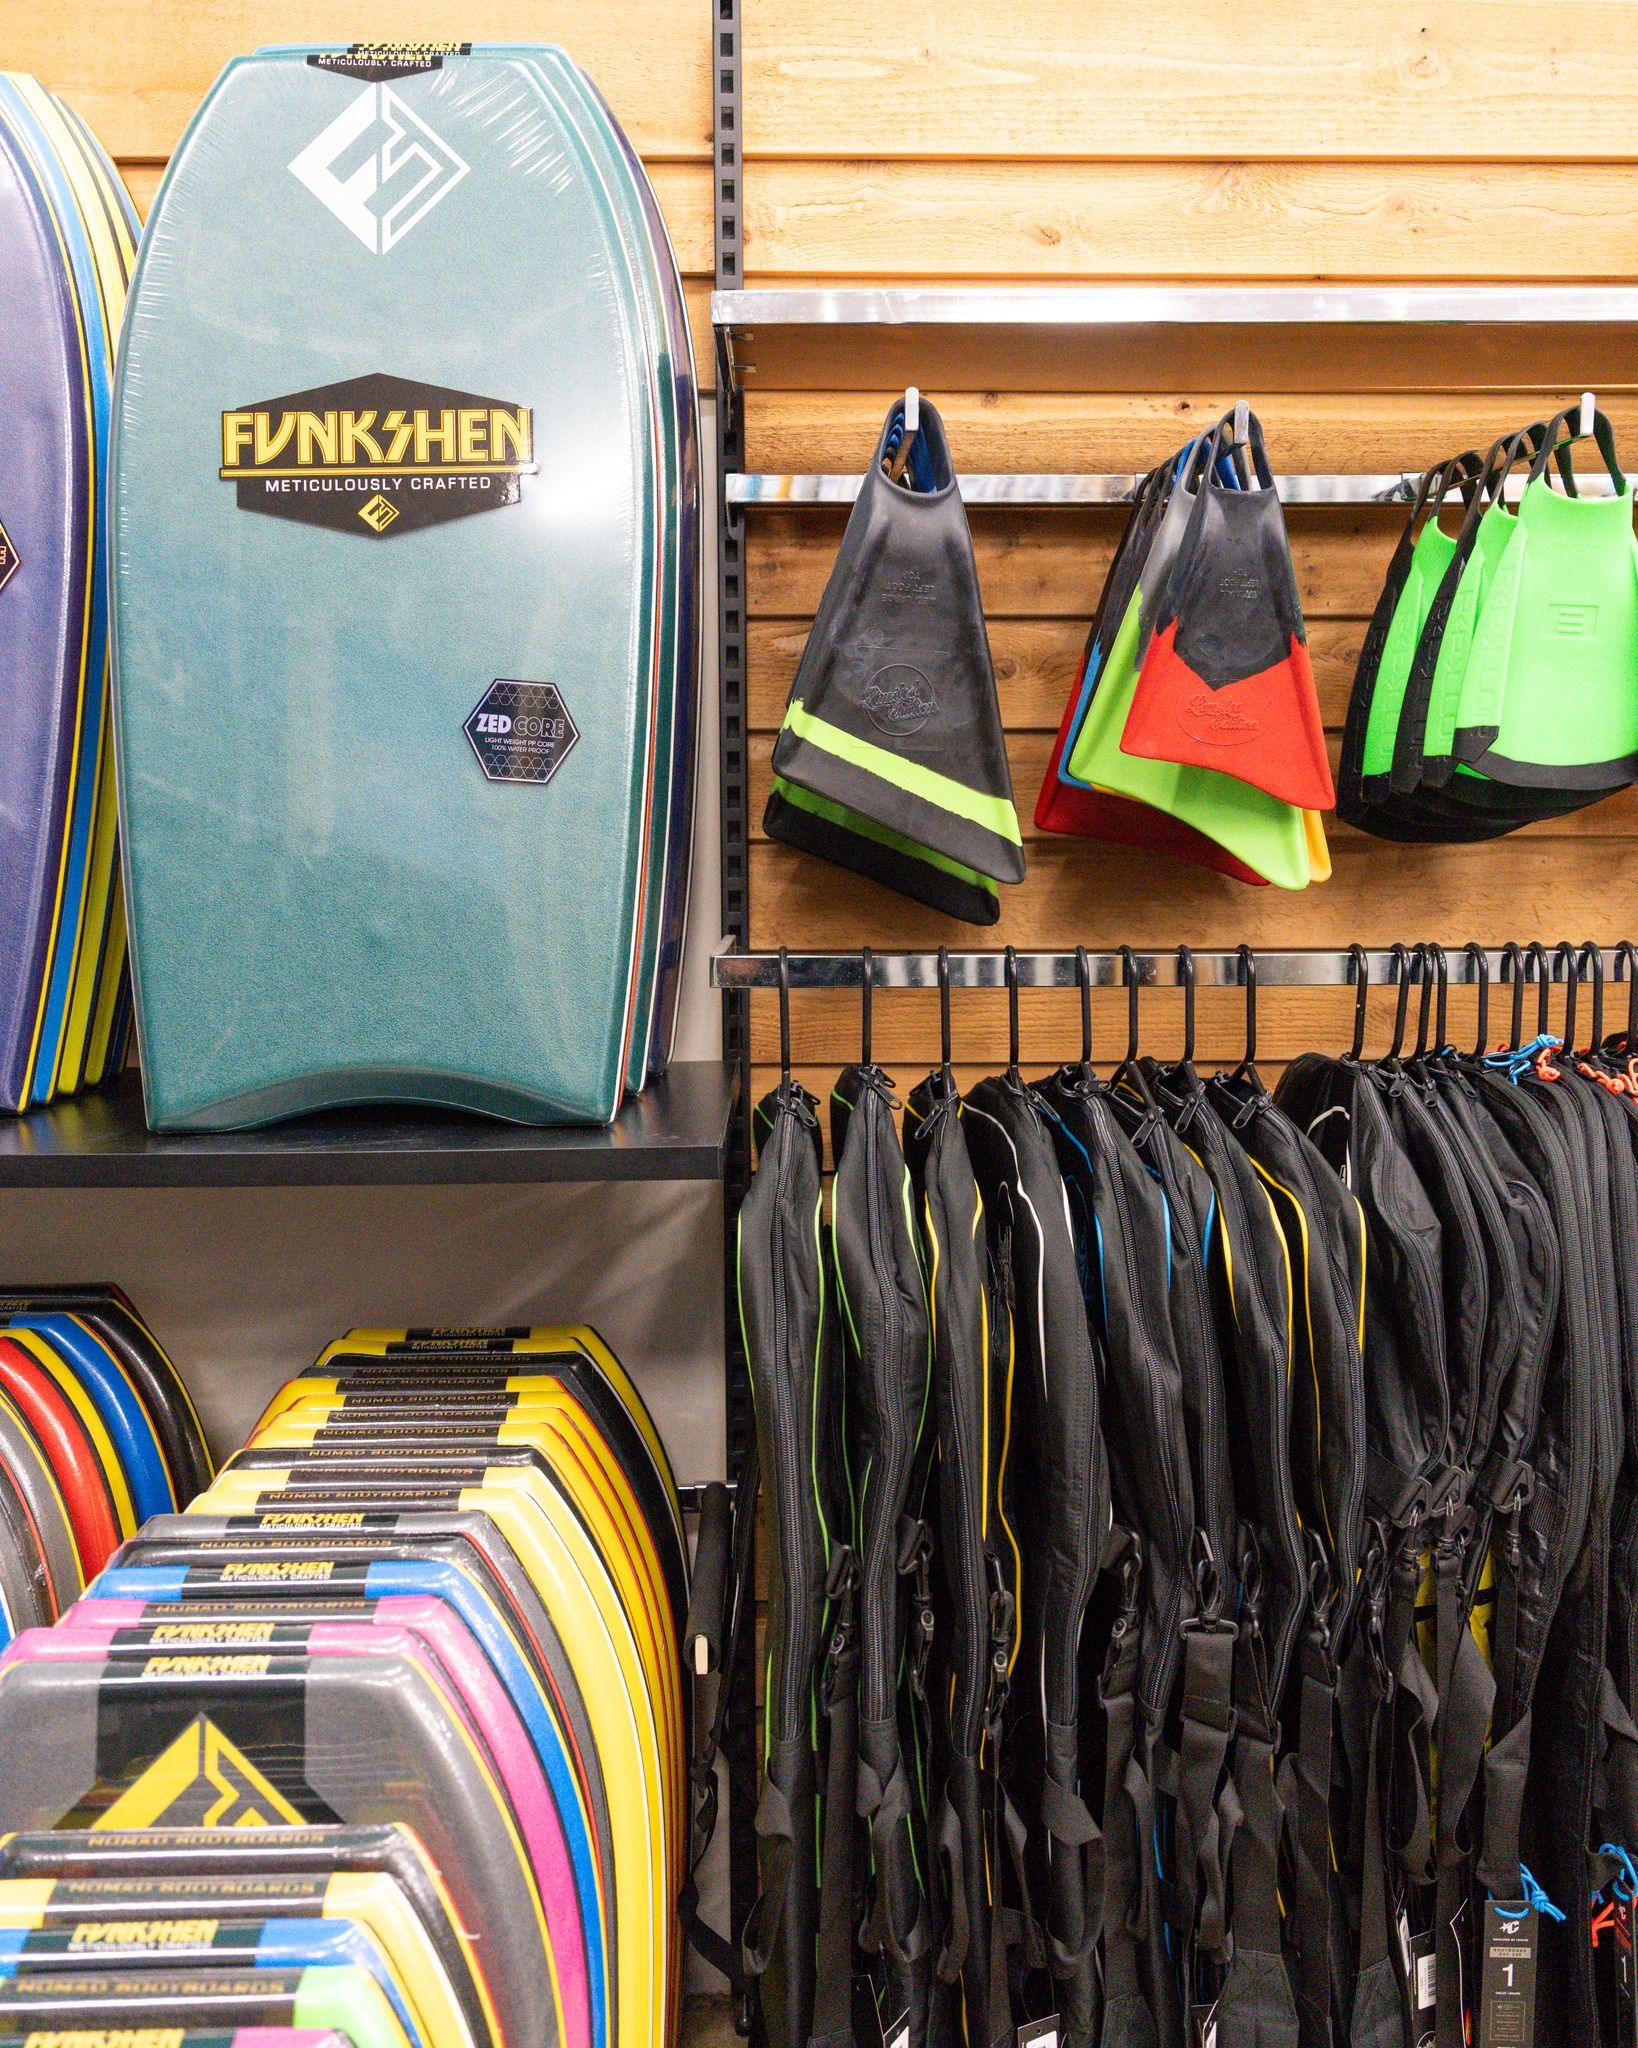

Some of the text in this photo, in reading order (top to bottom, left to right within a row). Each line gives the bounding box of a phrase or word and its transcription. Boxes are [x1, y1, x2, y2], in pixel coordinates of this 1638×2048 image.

[318, 58, 388, 66] METICULOUSLY
[265, 476, 491, 493] METICULOUSLY CRAFTED
[476, 713, 565, 738] ZED CORE
[503, 738, 527, 746] WEIGHT
[351, 1394, 506, 1404] NOMAD BODYBOARDS
[322, 1427, 486, 1436] NOMAD BODYBOARDS
[371, 1448, 477, 1456] BODYBOARDS
[269, 1490, 449, 1500] NOMAD BODYBOARDS
[1502, 1963, 1514, 1987] 1
